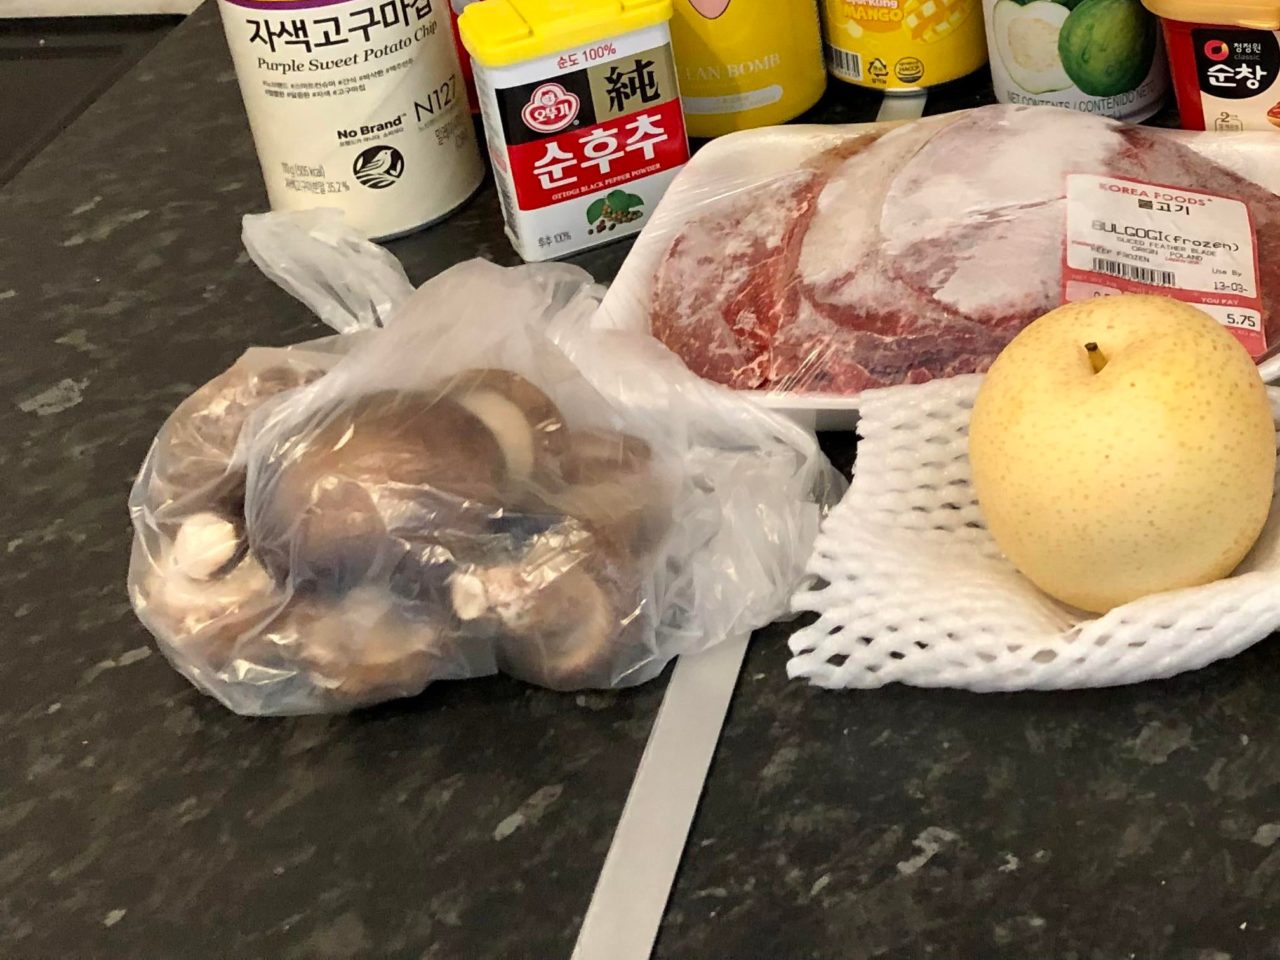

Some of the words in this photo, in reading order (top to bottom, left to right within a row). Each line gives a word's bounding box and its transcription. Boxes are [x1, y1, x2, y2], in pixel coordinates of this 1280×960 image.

[843, 5, 904, 22] MANGO
[257, 56, 305, 75] Purple
[308, 53, 359, 72] Sweet
[363, 36, 411, 63] Potato
[413, 19, 438, 43] Chip
[557, 53, 580, 70] 순도
[583, 43, 617, 63] 100%
[1233, 42, 1261, 54] 청정원
[726, 53, 781, 79] BOMB
[1206, 62, 1268, 90] 순창
[603, 58, 661, 114] 純
[413, 74, 457, 123] N127
[1078, 93, 1135, 113] CONTENIDO
[337, 129, 358, 140] No
[533, 114, 669, 190] 순후추
[552, 189, 581, 201] OTTOGI
[581, 180, 604, 194] BLACK
[605, 173, 631, 186] PEPPER
[631, 163, 662, 178] POWDER
[1100, 183, 1150, 199] KOREA
[1154, 192, 1206, 207] FOODS
[1137, 198, 1191, 216] 불고기
[1091, 246, 1113, 256] KEEP
[1116, 250, 1150, 263] FROZEN
[1116, 236, 1146, 246] SLICED
[1149, 241, 1187, 253] FEATHER
[1190, 246, 1217, 258] BLADE
[1131, 245, 1159, 256] ORIGIN
[1169, 250, 1204, 262] POLAND
[1211, 267, 1227, 276] Use
[1231, 269, 1242, 278] By
[1201, 297, 1220, 305] YOU
[1221, 298, 1240, 306] PAY
[1226, 313, 1256, 328] 5.75
